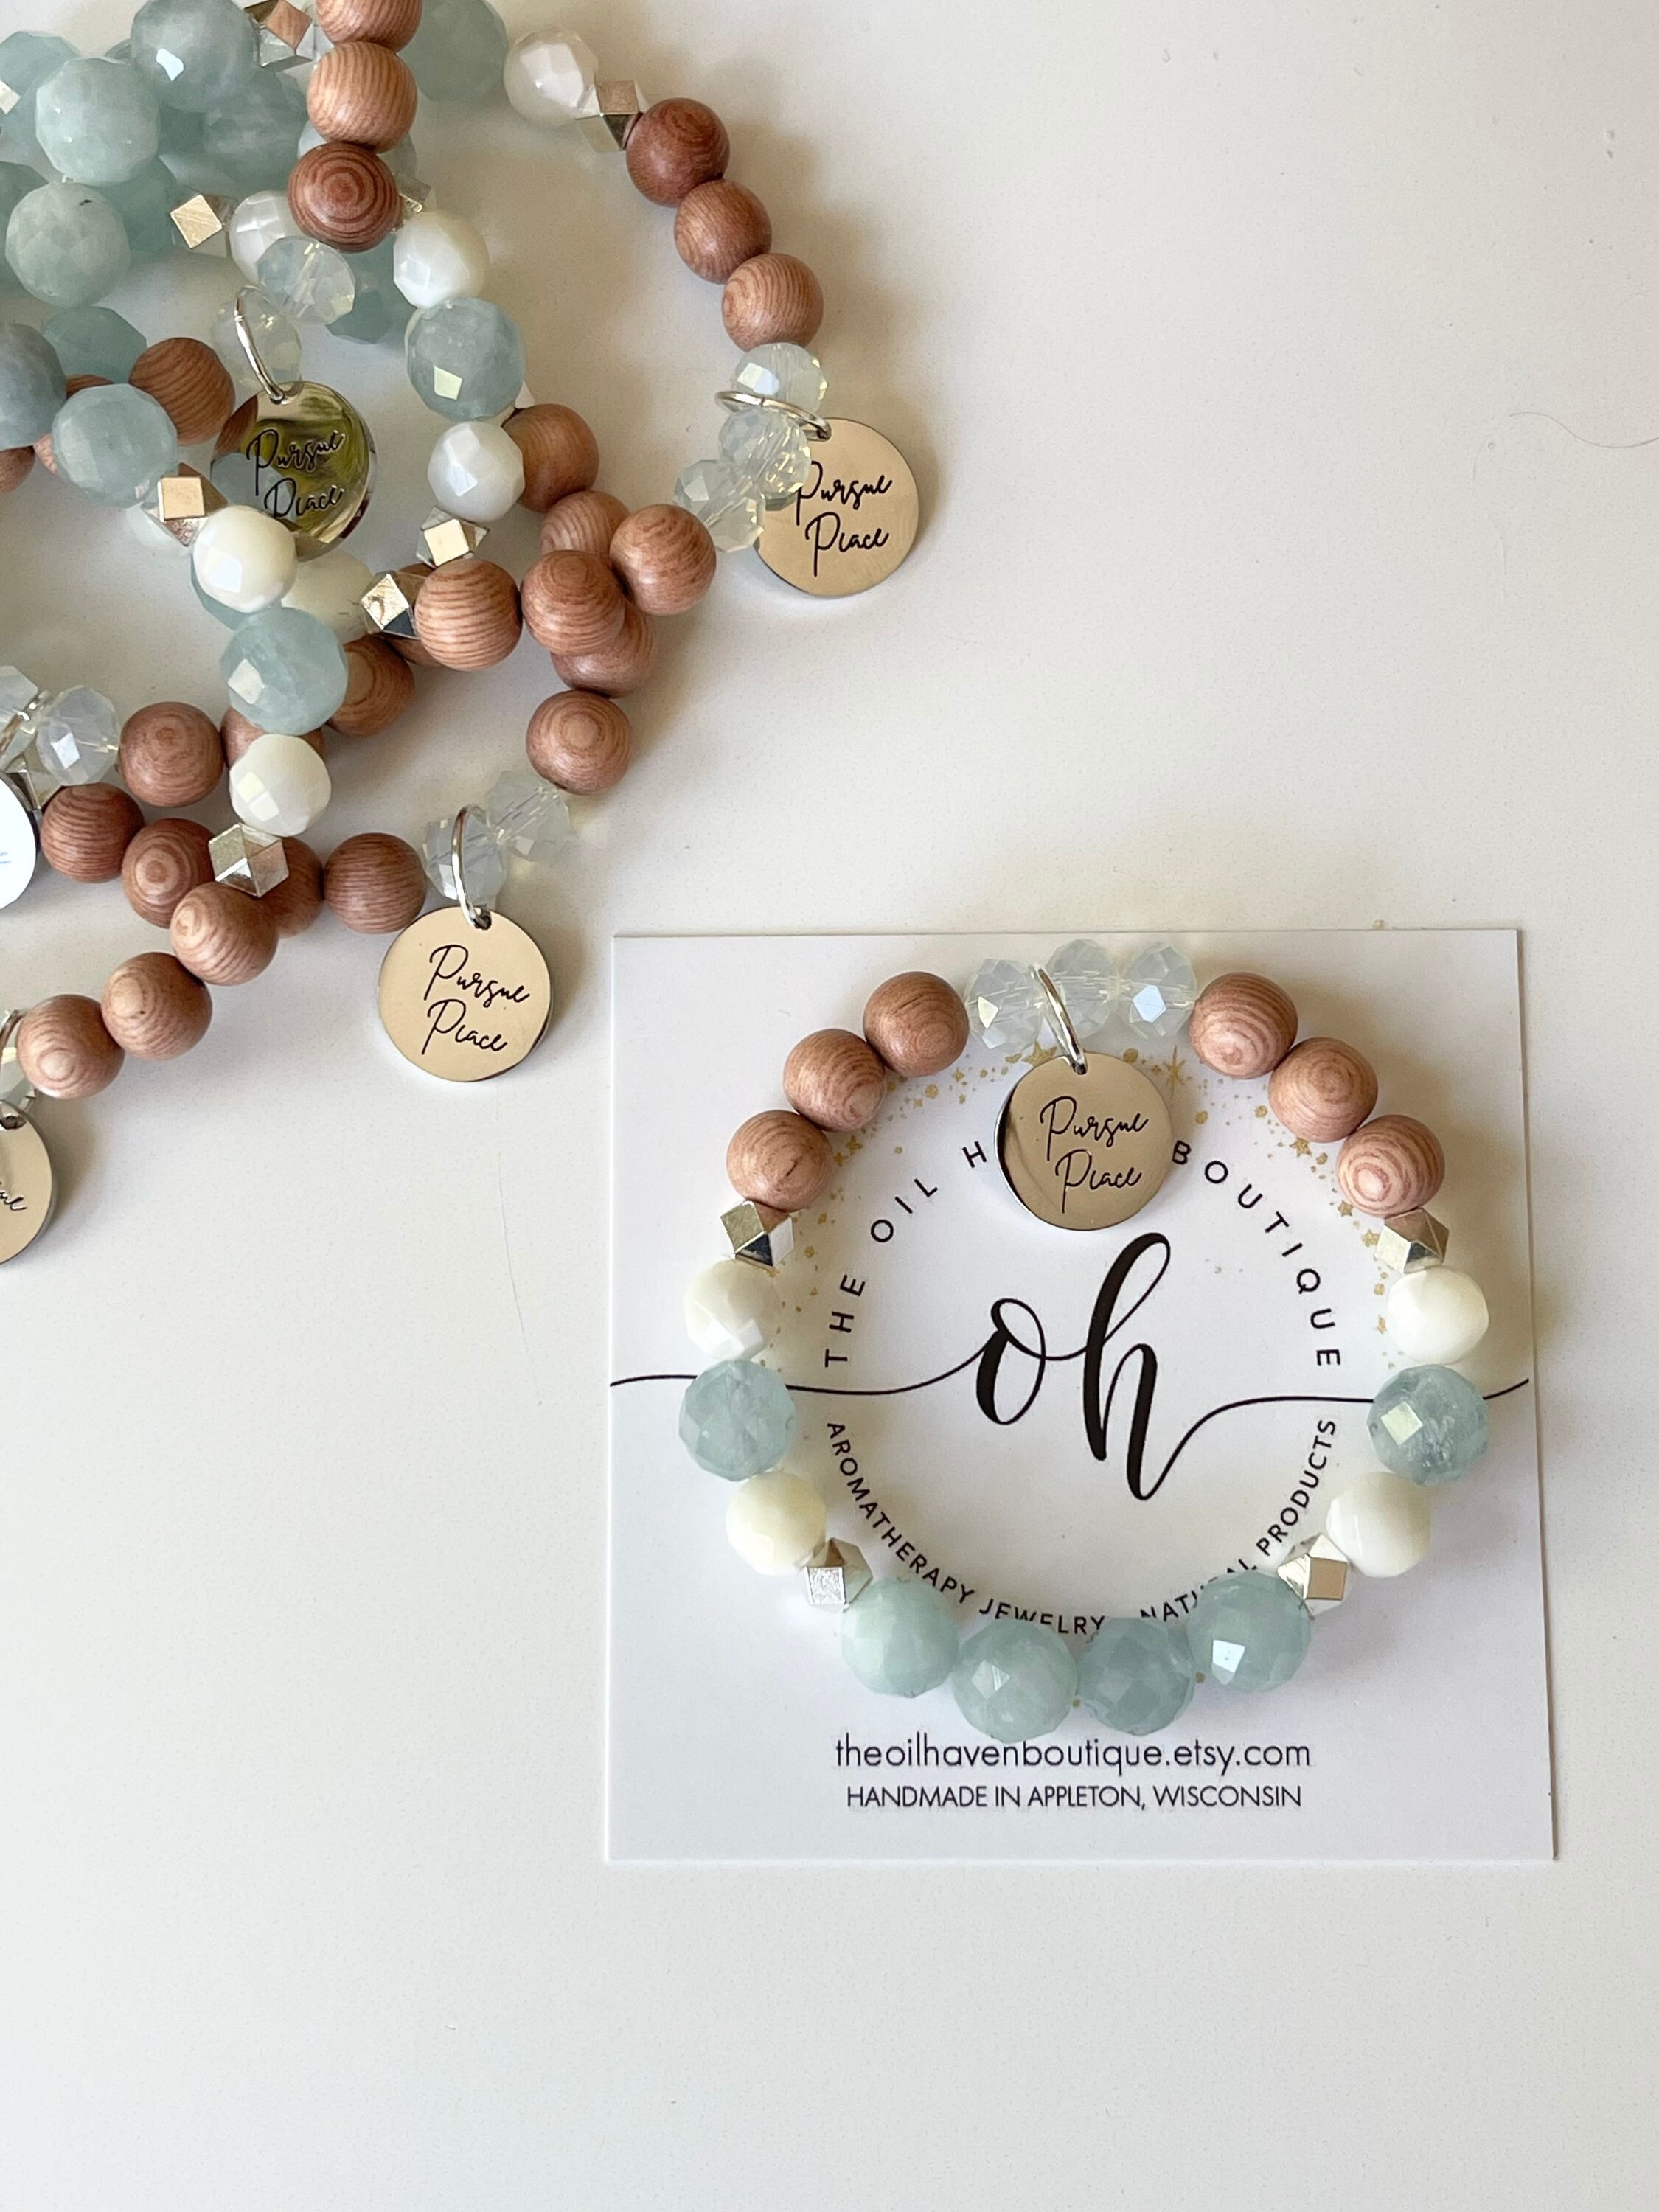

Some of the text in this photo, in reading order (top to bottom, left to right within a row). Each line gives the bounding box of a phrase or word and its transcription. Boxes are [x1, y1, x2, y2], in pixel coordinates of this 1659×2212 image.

[824, 1179, 938, 1368] THE OIL
[1172, 1140, 1341, 1366] BOUTIQUE
[827, 1422, 975, 1604] AROMATHERAPY
[978, 1598, 1106, 1635] JEWELRY
[1255, 1419, 1337, 1557] PRODUCTS
[835, 1731, 1310, 1777] theoilhavenboutique.etsy.com
[847, 1785, 1301, 1811] HANDMADE IN APPLETON, WISCONSIN
